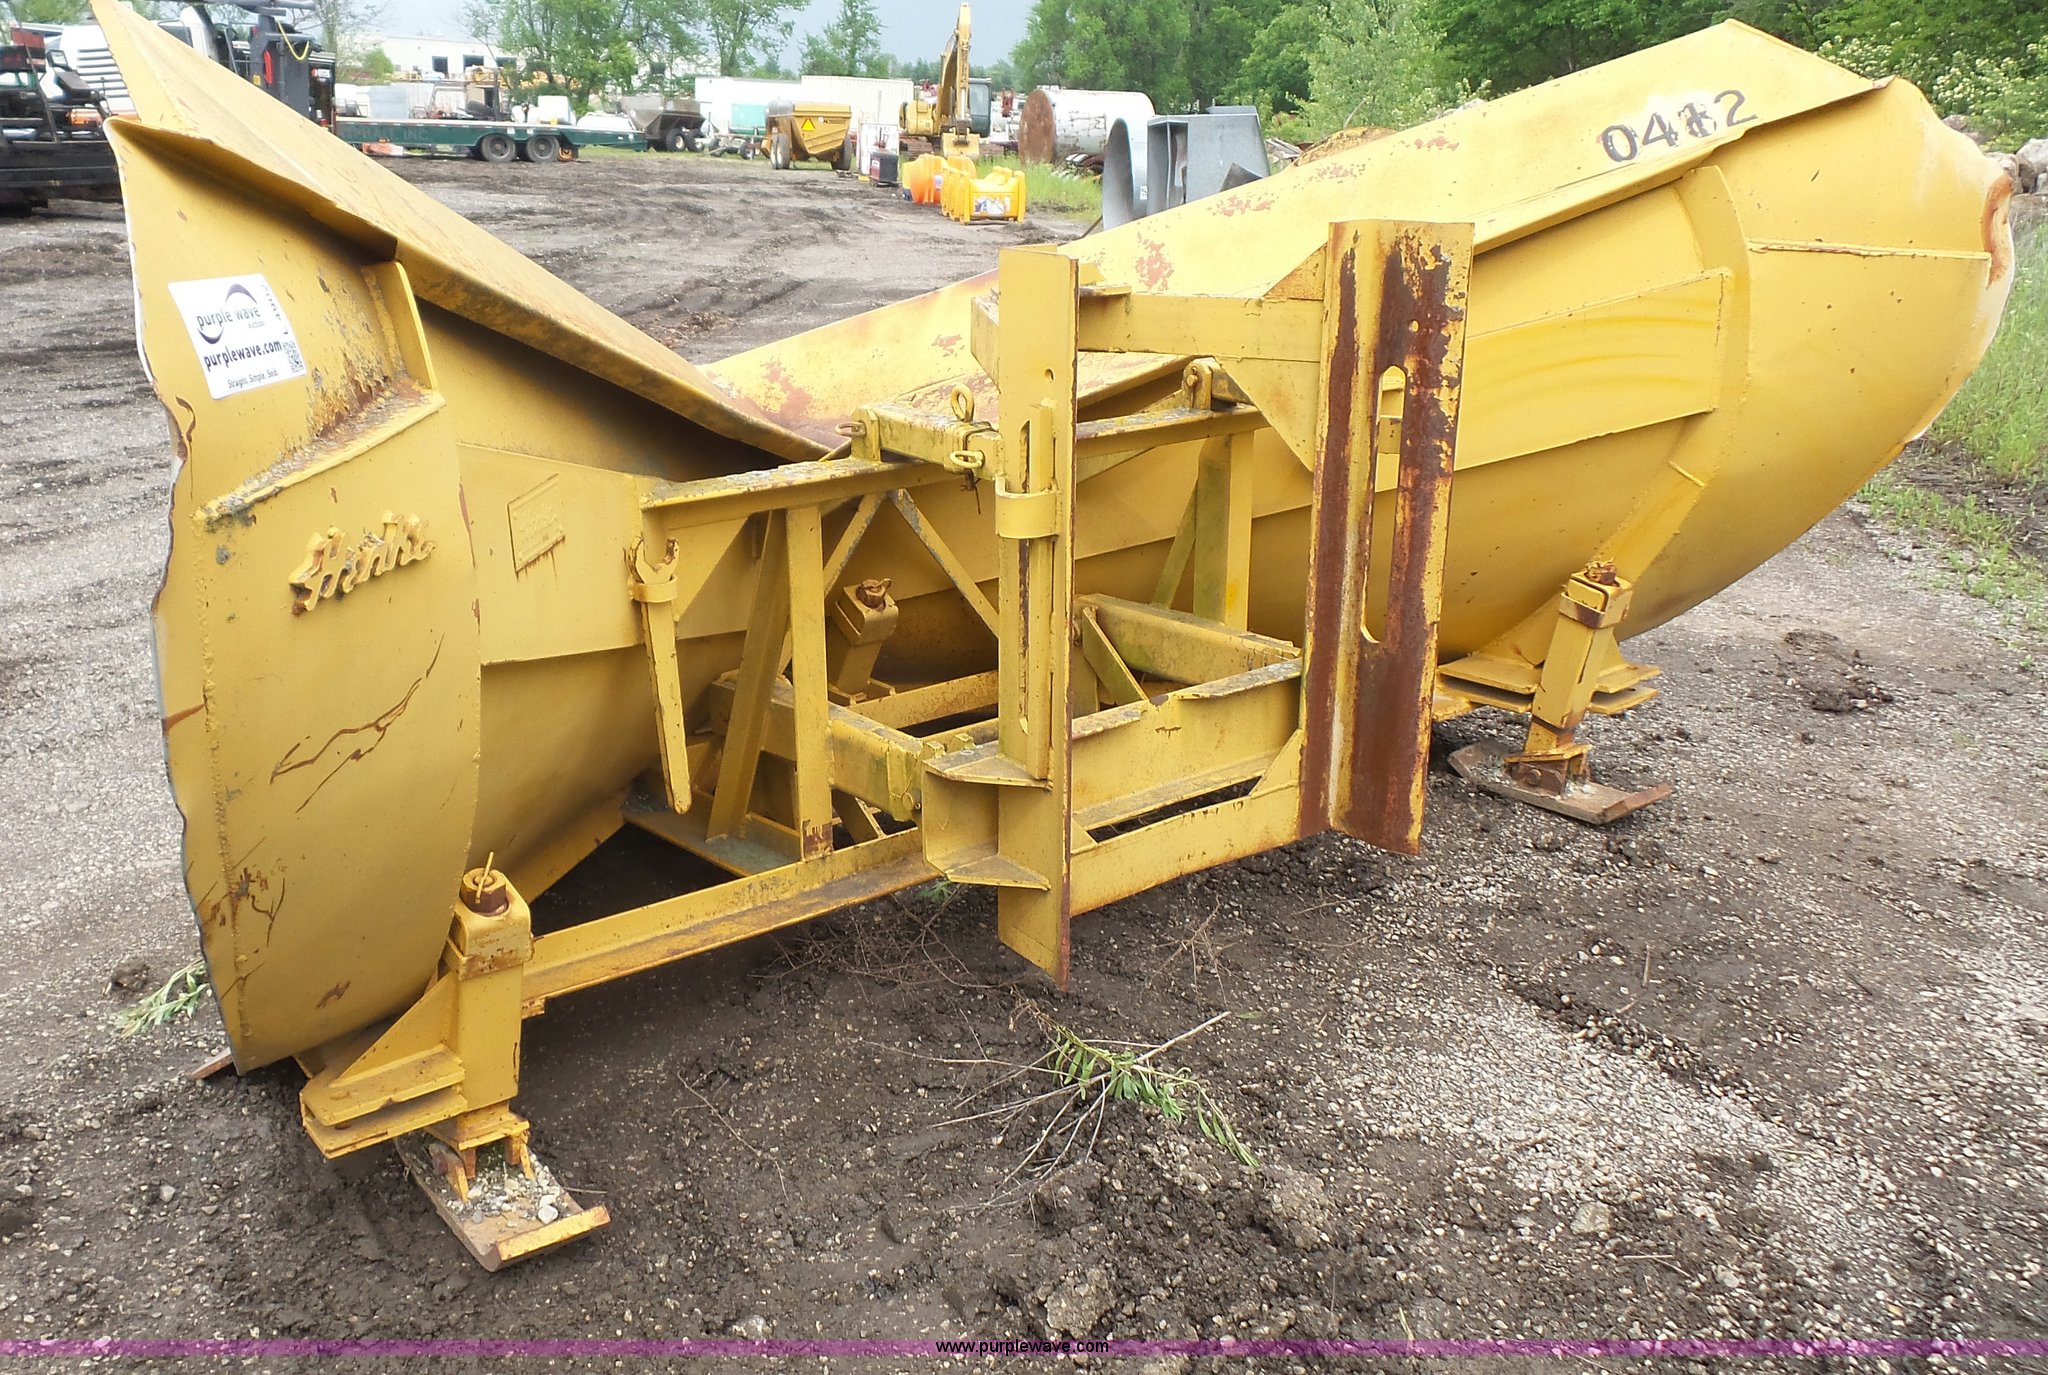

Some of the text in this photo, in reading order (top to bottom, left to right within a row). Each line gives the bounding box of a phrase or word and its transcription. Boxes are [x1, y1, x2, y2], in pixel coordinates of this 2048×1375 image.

[196, 308, 233, 331] purple
[234, 306, 261, 323] wave
[203, 340, 283, 373] purplewave.com
